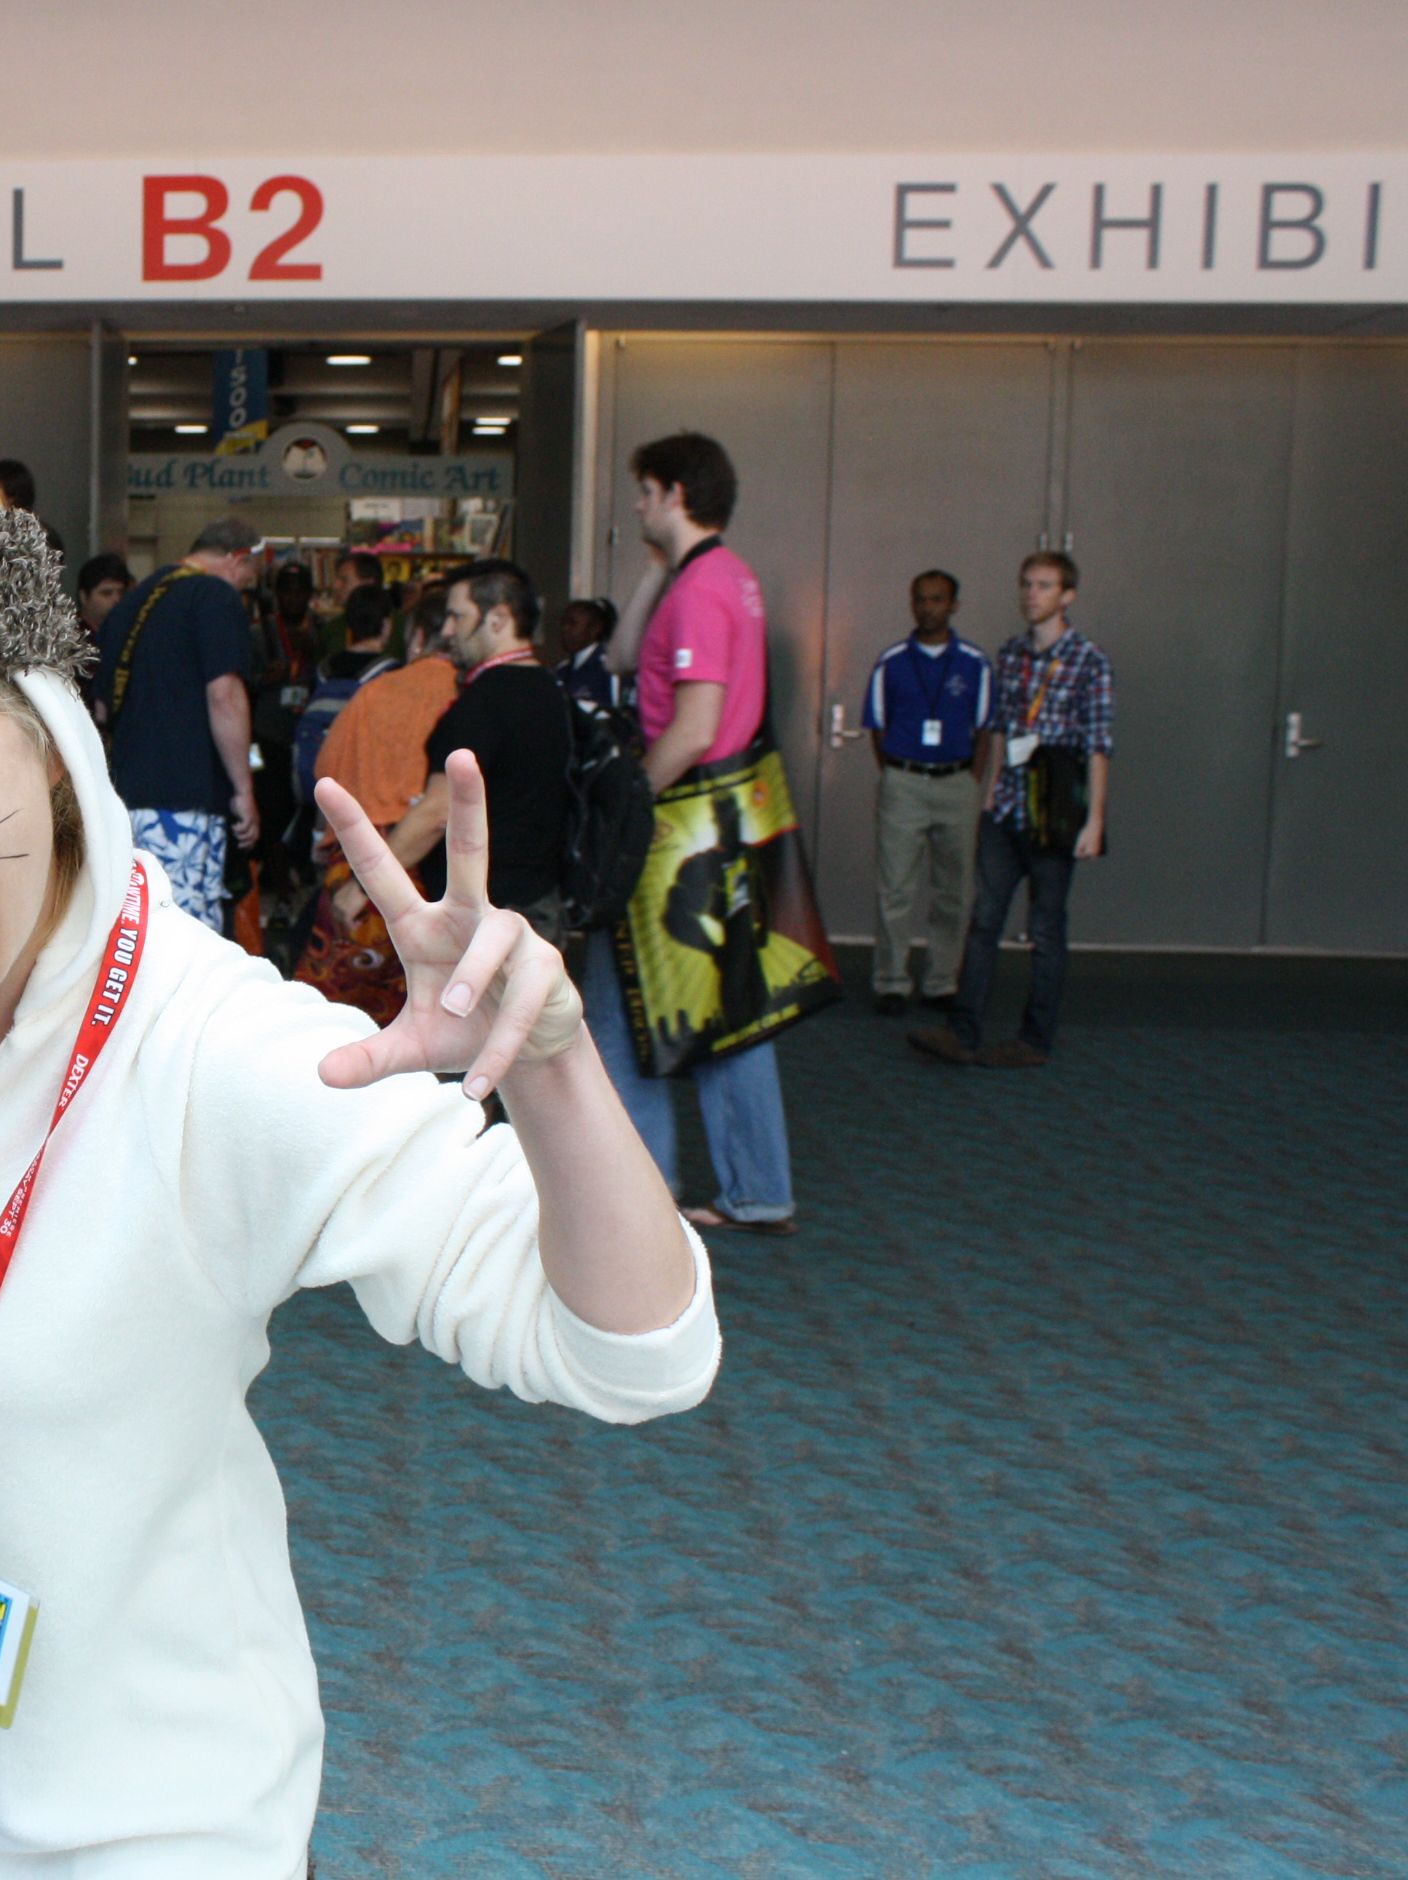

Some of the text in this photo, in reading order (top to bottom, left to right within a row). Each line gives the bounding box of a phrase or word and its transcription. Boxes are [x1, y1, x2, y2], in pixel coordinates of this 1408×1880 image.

[141, 174, 325, 283] B2
[892, 182, 1383, 271] EXHIBI
[183, 459, 271, 488] Plant
[339, 461, 435, 490] Comic
[446, 464, 499, 491] Art
[113, 927, 139, 966] YOU
[103, 966, 128, 1004] GET
[91, 1002, 116, 1027] IT.
[58, 1053, 90, 1108] DEXTER
[8, 1187, 24, 1218] SEPT
[0, 1218, 12, 1236] 30
